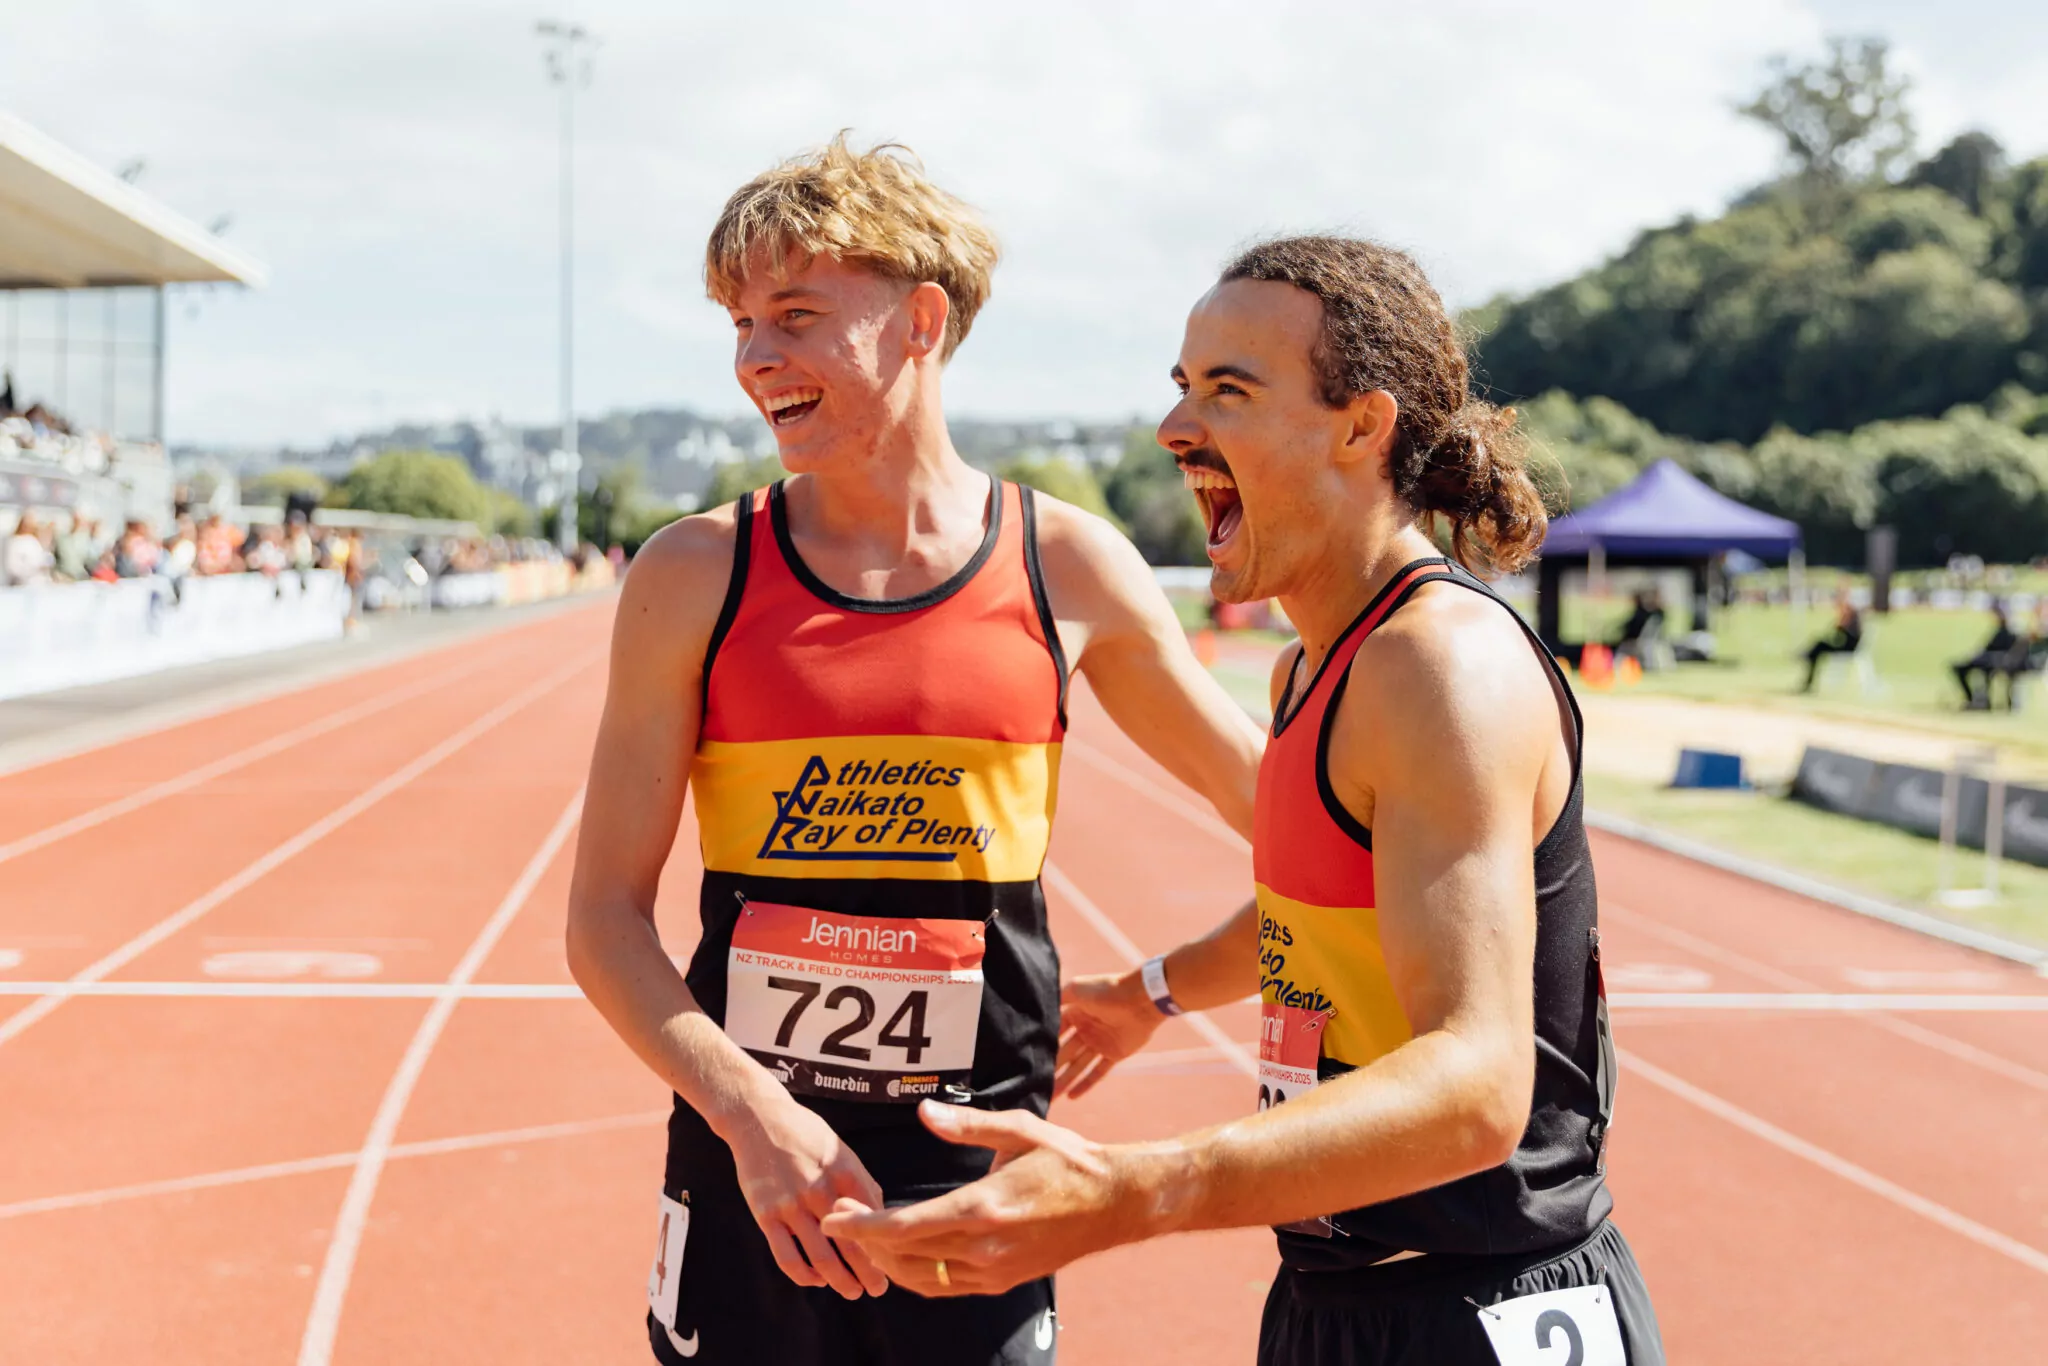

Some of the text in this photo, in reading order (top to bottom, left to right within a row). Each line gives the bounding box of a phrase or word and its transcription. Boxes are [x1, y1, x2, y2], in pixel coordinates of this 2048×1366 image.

[797, 755, 966, 789] Athletics
[855, 818, 898, 845] of
[898, 818, 996, 853] Plenty
[801, 916, 917, 953] Jennian
[736, 952, 753, 964] NZ
[756, 955, 797, 972] TRACK
[797, 962, 805, 972] &
[808, 964, 842, 978] FIELD
[845, 968, 944, 985] CHAMPIONSHIPS
[830, 950, 893, 964] HOMES
[767, 975, 932, 1065] 724
[902, 1075, 940, 1084] SUMMER
[1294, 1070, 1312, 1086] 2025
